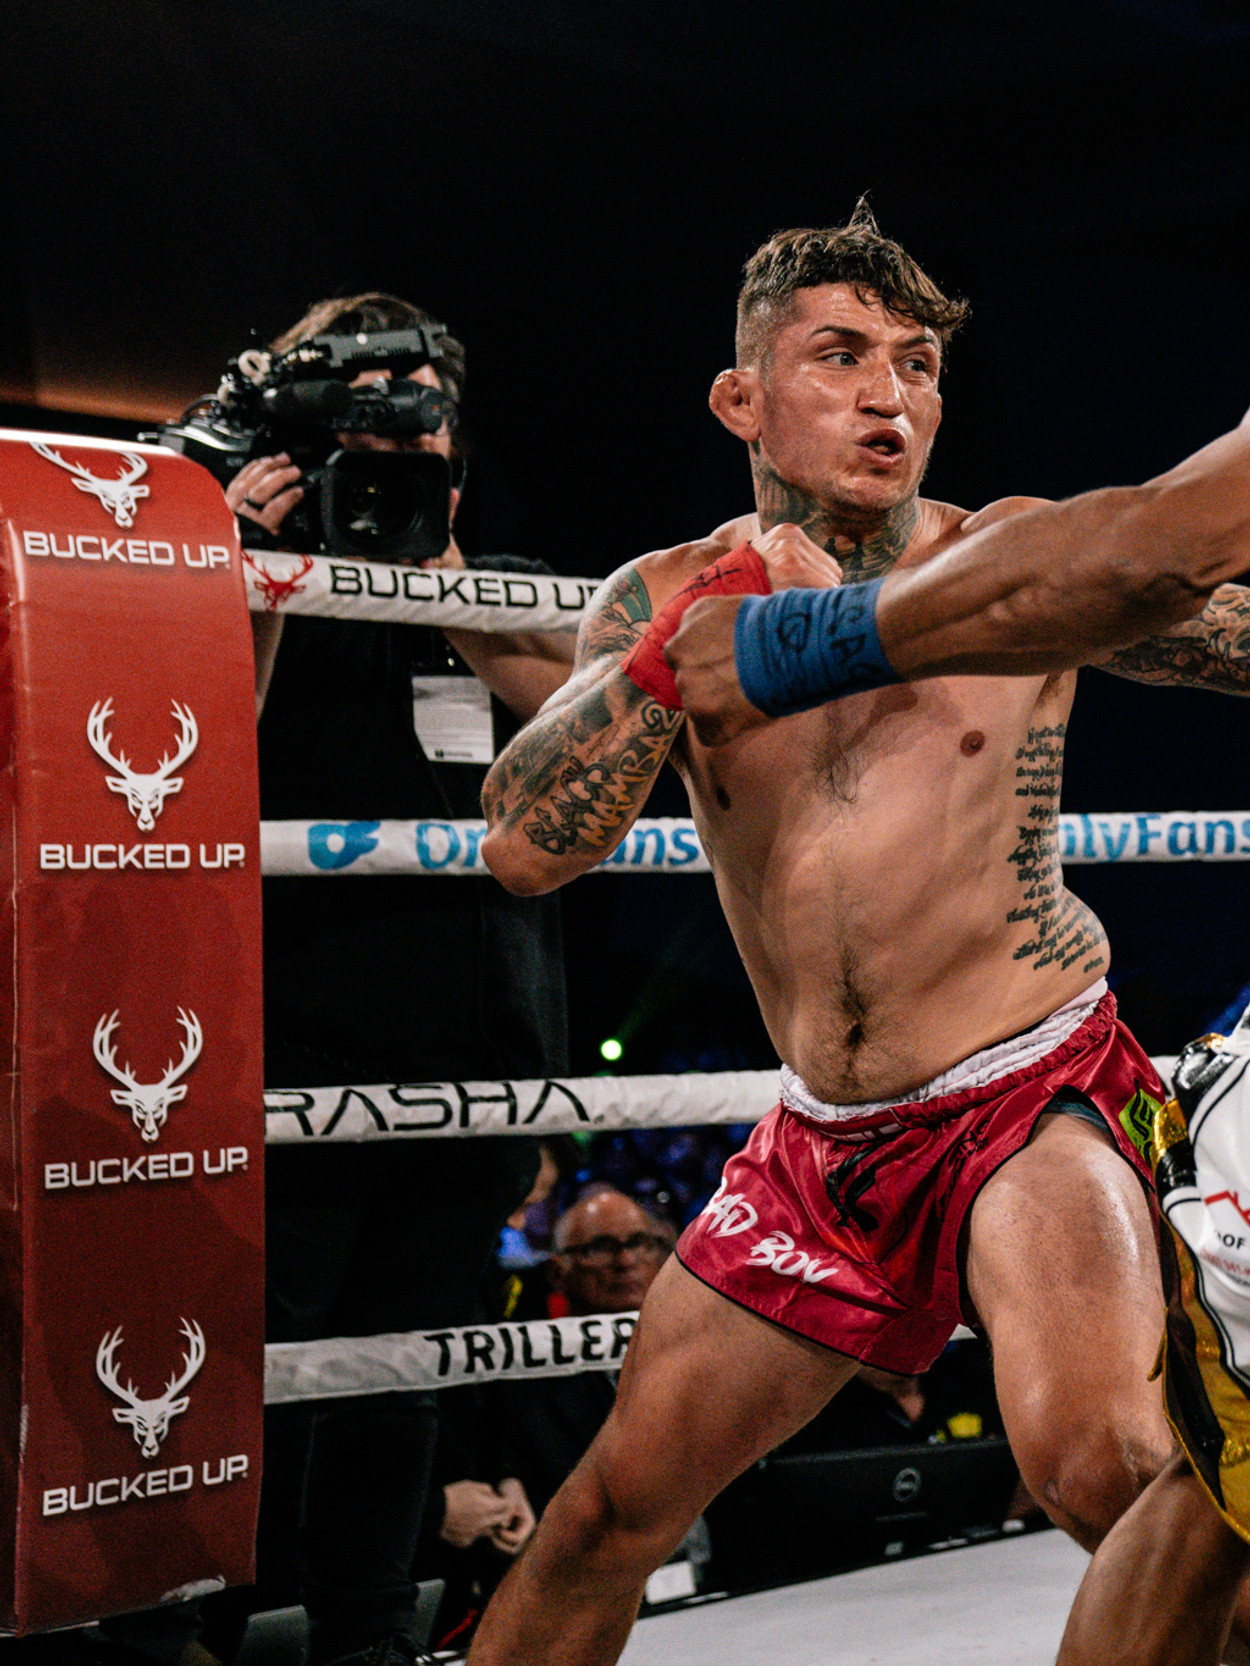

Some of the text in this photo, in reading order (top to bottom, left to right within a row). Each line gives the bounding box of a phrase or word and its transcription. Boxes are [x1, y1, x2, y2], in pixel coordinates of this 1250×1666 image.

[23, 530, 230, 568] BUCKED UP
[329, 564, 538, 608] BUCKED
[40, 844, 245, 869] BUCKED UP
[264, 1079, 592, 1136] RASHA
[44, 1146, 248, 1189] BUCKED UP
[423, 1318, 637, 1376] TRILLER
[42, 1454, 248, 1516] BUCKED UP
